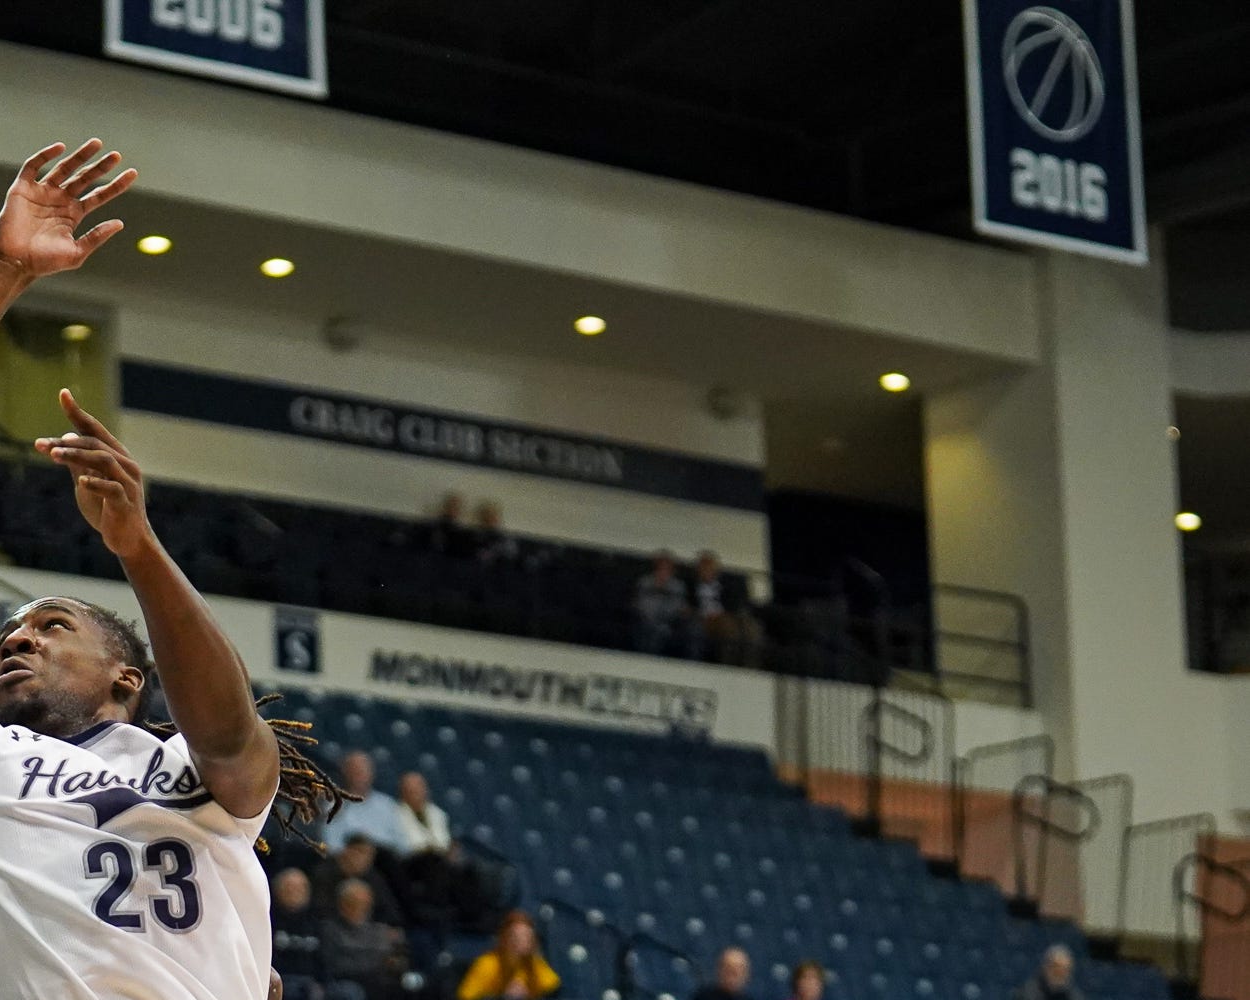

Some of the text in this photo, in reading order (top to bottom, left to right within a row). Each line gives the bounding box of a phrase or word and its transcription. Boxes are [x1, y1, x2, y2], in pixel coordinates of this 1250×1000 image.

[1010, 147, 1109, 223] 2016
[18, 746, 204, 799] Hawks
[83, 836, 203, 934] 23
